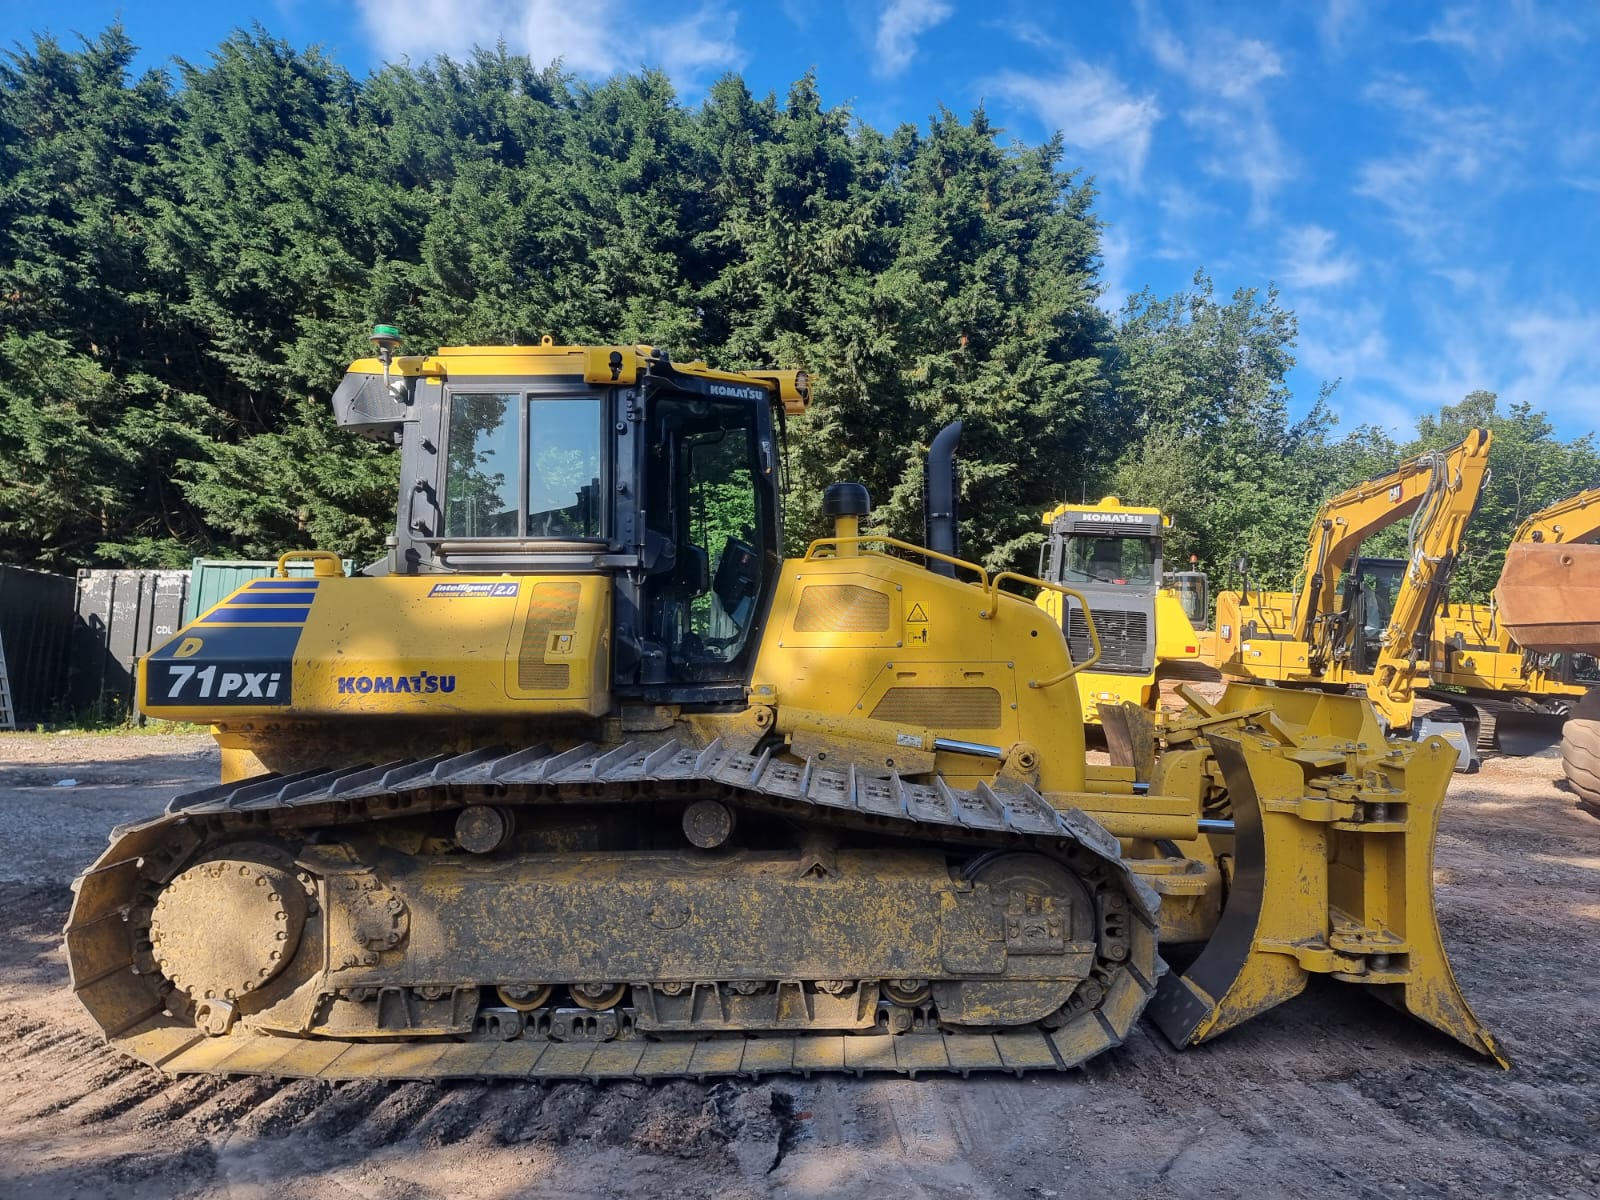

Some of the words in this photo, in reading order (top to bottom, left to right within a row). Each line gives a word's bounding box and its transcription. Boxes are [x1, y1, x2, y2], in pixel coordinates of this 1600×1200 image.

[710, 385, 763, 400] KOMATSU
[1082, 513, 1143, 523] KOMATSU
[434, 584, 493, 592] Intelligent
[494, 585, 516, 595] 2.0
[155, 625, 173, 635] CDL
[172, 637, 204, 658] D
[338, 671, 456, 694] KOMATSU
